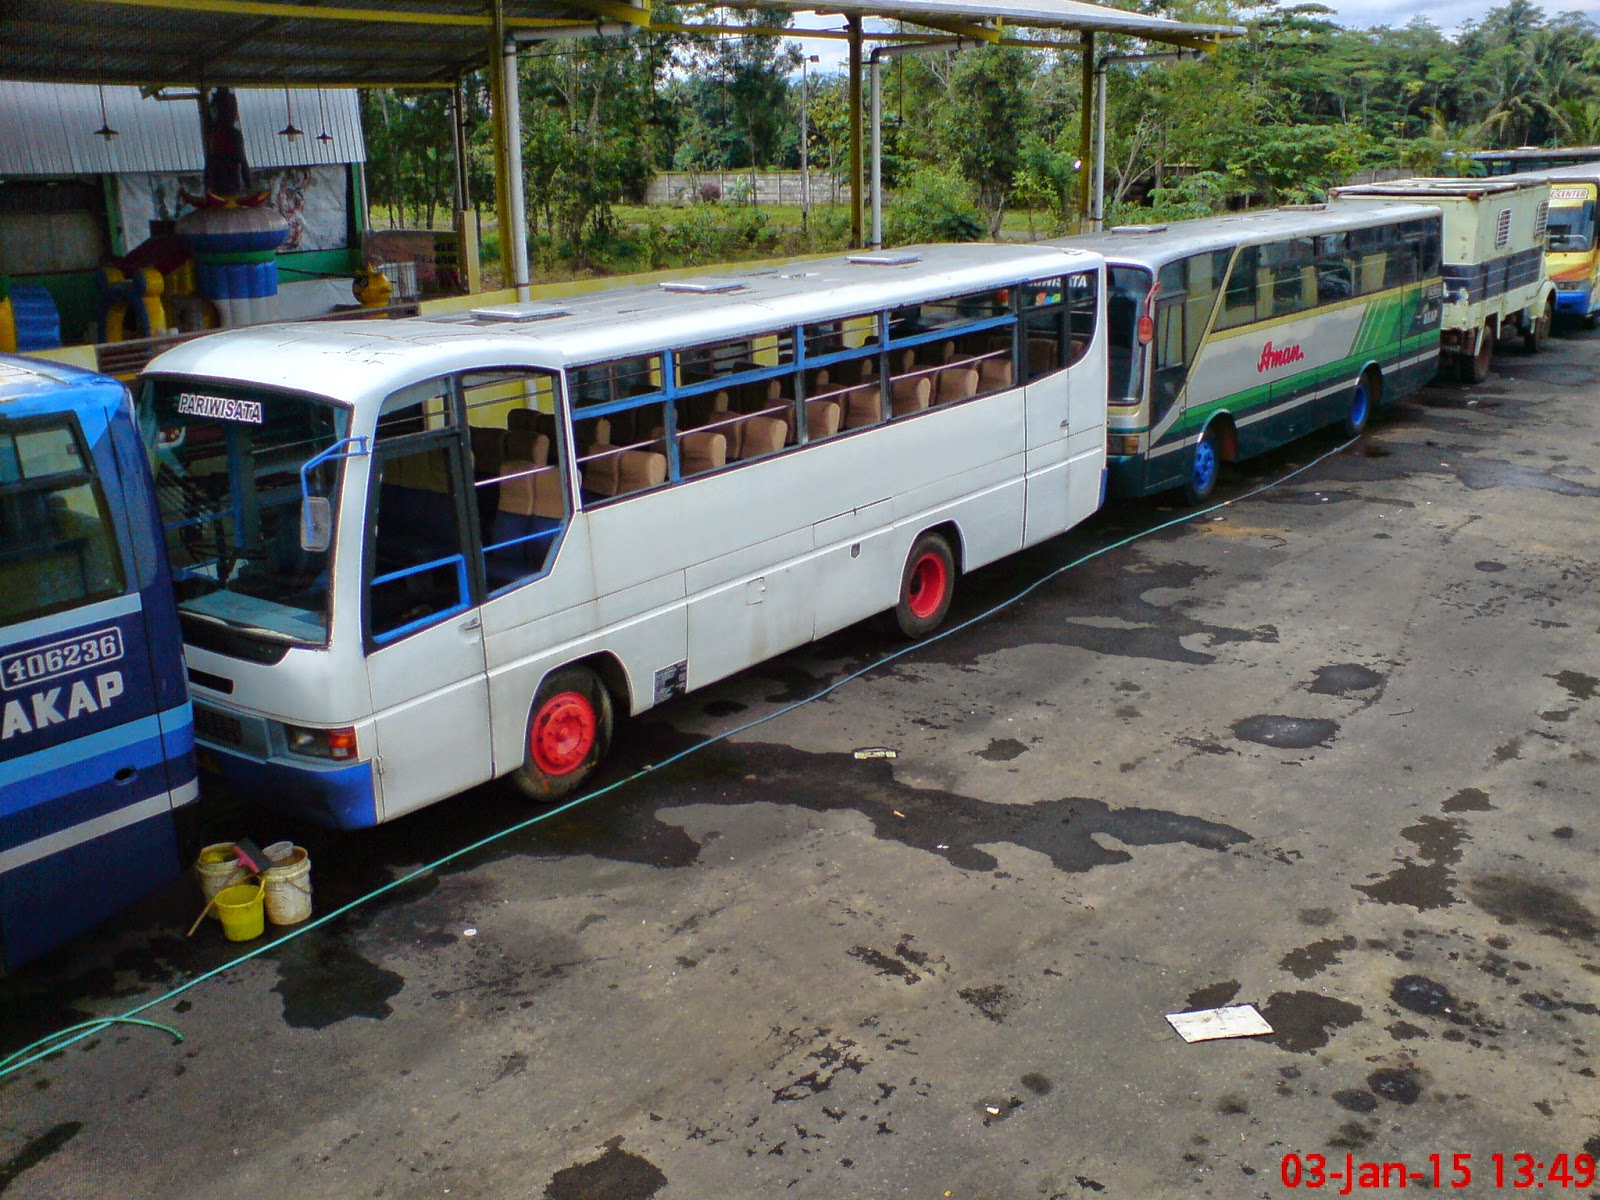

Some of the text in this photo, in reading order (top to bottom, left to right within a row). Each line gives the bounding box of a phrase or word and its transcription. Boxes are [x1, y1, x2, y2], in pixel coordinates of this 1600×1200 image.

[1557, 190, 1587, 198] CENTER
[178, 393, 262, 423] PARIWISATA
[7, 635, 117, 682] 406236
[2, 671, 124, 739] AKAP
